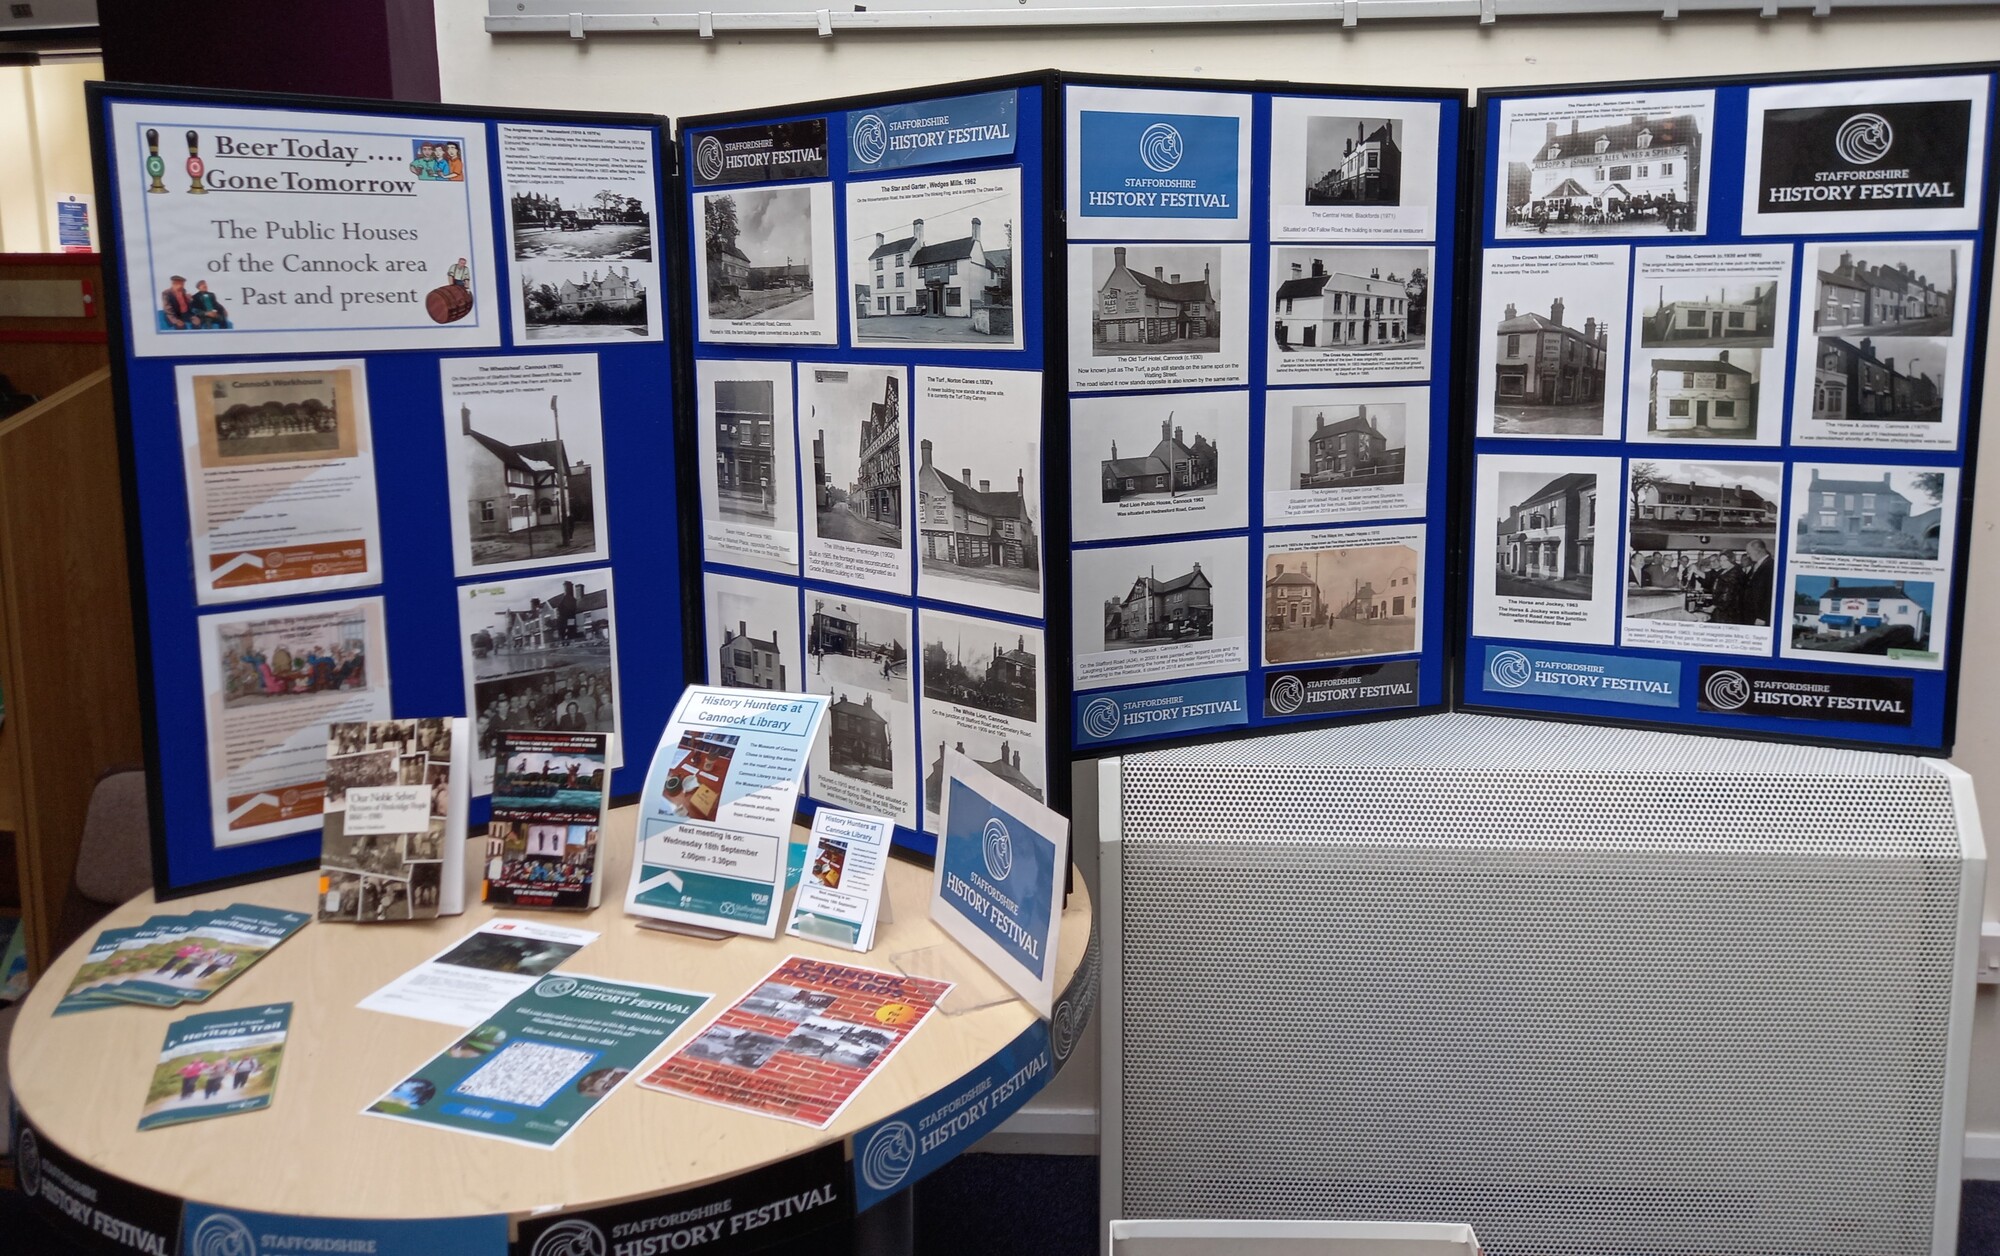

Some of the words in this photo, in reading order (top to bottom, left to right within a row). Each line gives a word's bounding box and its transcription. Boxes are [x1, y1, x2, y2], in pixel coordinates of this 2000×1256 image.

[890, 116, 949, 131] STAFFORDSHIRE
[725, 139, 773, 151] STAFFORDSHIRE
[890, 132, 945, 150] HISTORY
[948, 124, 1009, 144] FESTIVAL
[215, 136, 278, 157] Beer
[281, 138, 359, 166] Today
[726, 152, 770, 168] HISTORY
[772, 148, 822, 165] FESTIVAL
[1605, 152, 1619, 162] ALES
[206, 169, 278, 190] Gone
[281, 172, 415, 193] Tomorrow
[1125, 179, 1196, 188] STAFFORDSHIRE
[1814, 170, 1909, 181] STAFFORDSHIRE
[1089, 192, 1157, 206] HISTORY
[1161, 193, 1229, 207] FESTIVAL
[1769, 185, 1856, 202] HISTORY
[1859, 182, 1954, 199] FESTIVAL
[211, 220, 257, 240] The
[266, 221, 335, 241] Public
[342, 222, 418, 241] Houses
[207, 253, 232, 272] of
[238, 254, 274, 272] the
[282, 254, 378, 272] Cannock
[385, 258, 427, 272] area
[241, 287, 287, 305] Past
[294, 287, 334, 304] and
[340, 288, 418, 313] present
[1535, 661, 1604, 673] STAFFORDSHIRE
[1307, 677, 1362, 688] STAFFORDSHIRE
[1534, 671, 1599, 687] HISTORY
[1602, 677, 1672, 694] FESTIVAL
[1754, 680, 1830, 693] STAFFORDSHIRE
[1123, 696, 1183, 710] STAFFORDSHIRE
[1307, 688, 1357, 703] HISTORY
[1360, 683, 1412, 698] FESTIVAL
[1754, 692, 1824, 707] HISTORY
[1827, 696, 1905, 713] FESTIVAL
[702, 696, 742, 709] History
[744, 699, 788, 711] Hunters
[790, 704, 802, 713] at
[963, 709, 975, 717] White
[1123, 708, 1180, 725] HISTORY
[1182, 700, 1241, 717] FESTIVAL
[699, 712, 746, 724] Cannock
[750, 716, 790, 731] Library
[825, 815, 846, 826] History
[847, 819, 869, 830] Hunters
[679, 826, 694, 834] Next
[696, 829, 723, 840] meeting
[825, 826, 851, 836] Cannock
[852, 831, 872, 842] Library
[663, 836, 702, 849] Wednesday
[704, 842, 719, 851] 18th
[720, 844, 758, 856] September
[712, 856, 736, 866] 3.30pm
[752, 892, 769, 902] YOUR
[970, 871, 1019, 916] STAFFORDSHIRE
[947, 871, 990, 917] HISTORY
[990, 906, 1038, 961] FESTIVAL
[209, 919, 258, 932] Heritage
[260, 926, 286, 935] Trail
[800, 960, 904, 986] CANNOCK
[572, 989, 630, 1004] HISTORY
[629, 996, 690, 1014] FESTIVAL
[183, 1027, 246, 1041] Heritage
[250, 1021, 281, 1032] Trail
[919, 1076, 992, 1131] STAFFORDSHIRE
[920, 1096, 988, 1155] HISTORY
[991, 1052, 1048, 1109] FESTIVAL
[612, 1199, 732, 1238] STAFFORDSHIRE
[613, 1220, 724, 1256] HISTORY
[730, 1183, 837, 1235] FESTIVAL
[93, 1210, 168, 1256] FESTIVAL
[261, 1234, 376, 1253] STAFFORDSHIRE
